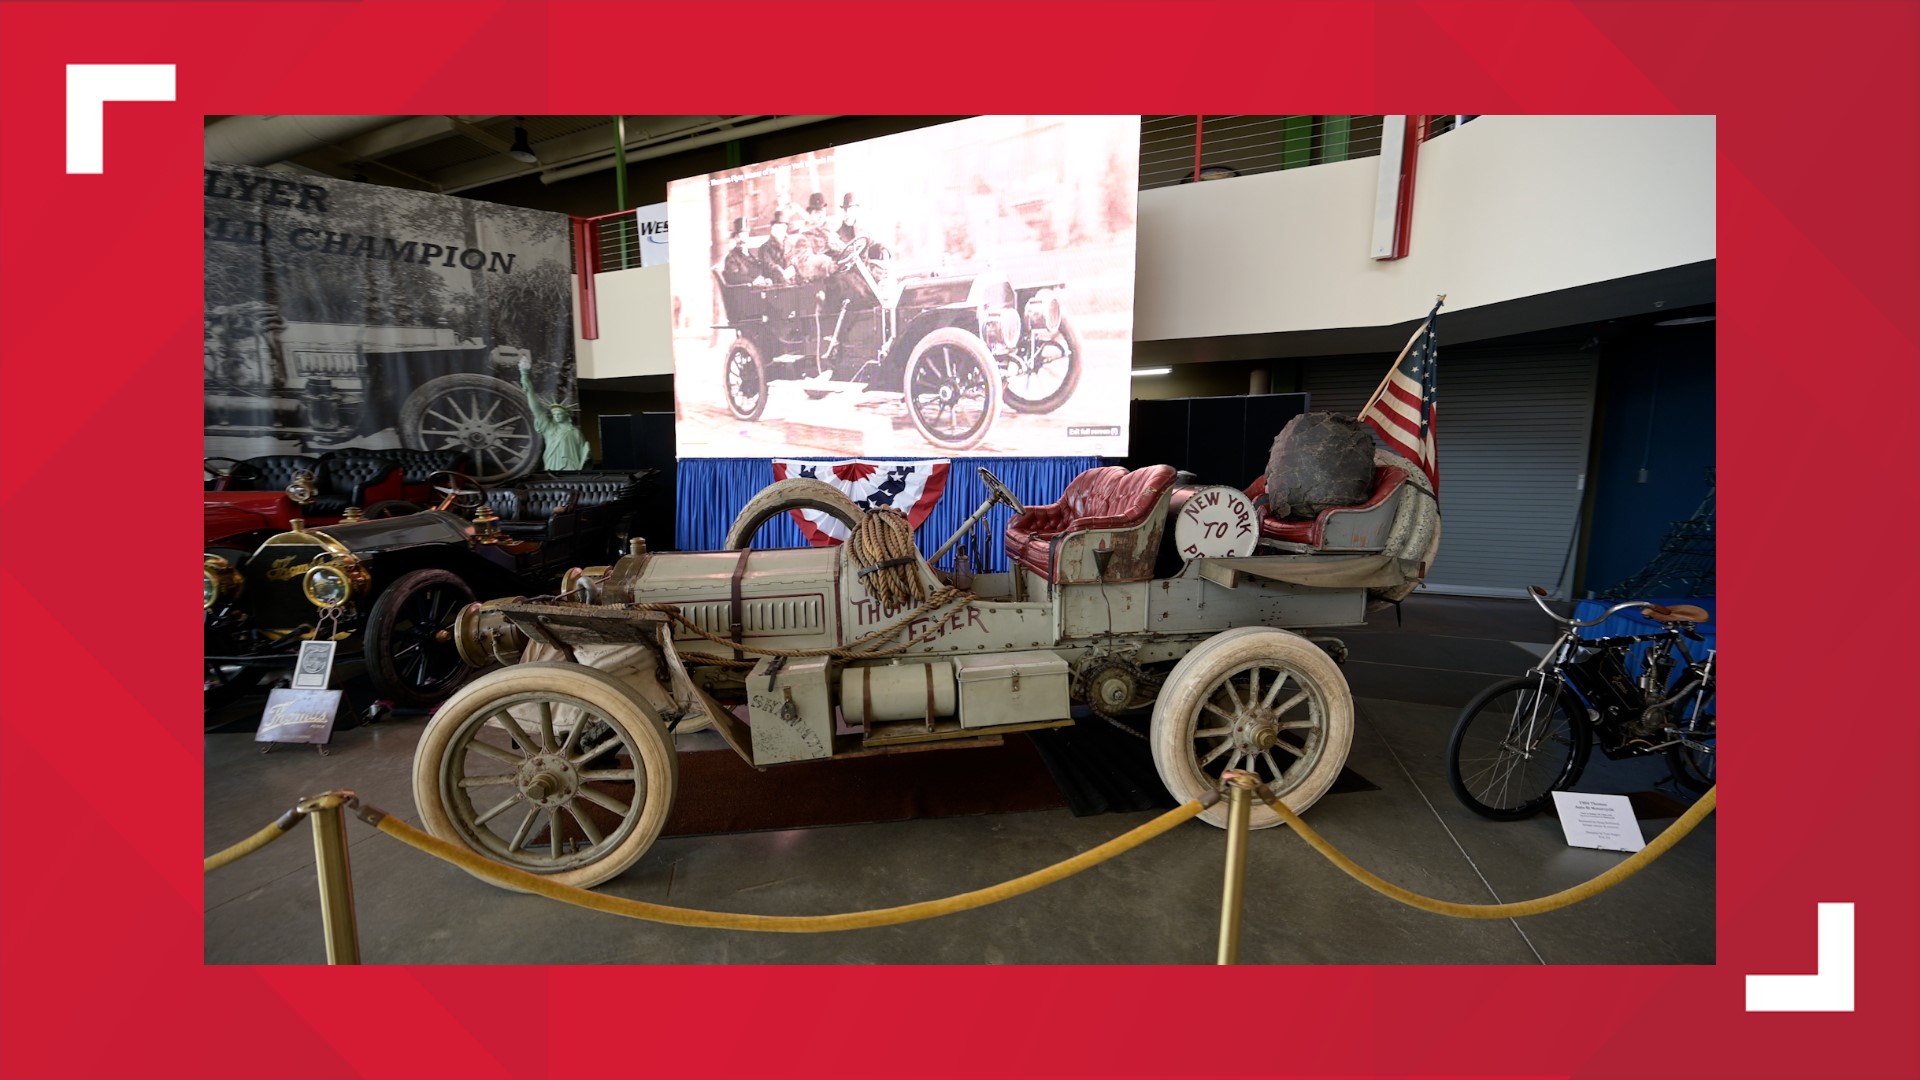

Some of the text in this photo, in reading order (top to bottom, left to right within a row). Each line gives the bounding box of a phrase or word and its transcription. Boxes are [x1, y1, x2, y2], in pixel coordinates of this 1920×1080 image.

[204, 169, 328, 213] LYER
[289, 228, 516, 275] CHAMPION
[1184, 492, 1252, 539] NEW YORK
[1203, 522, 1228, 539] TO
[908, 606, 990, 643] FLYER
